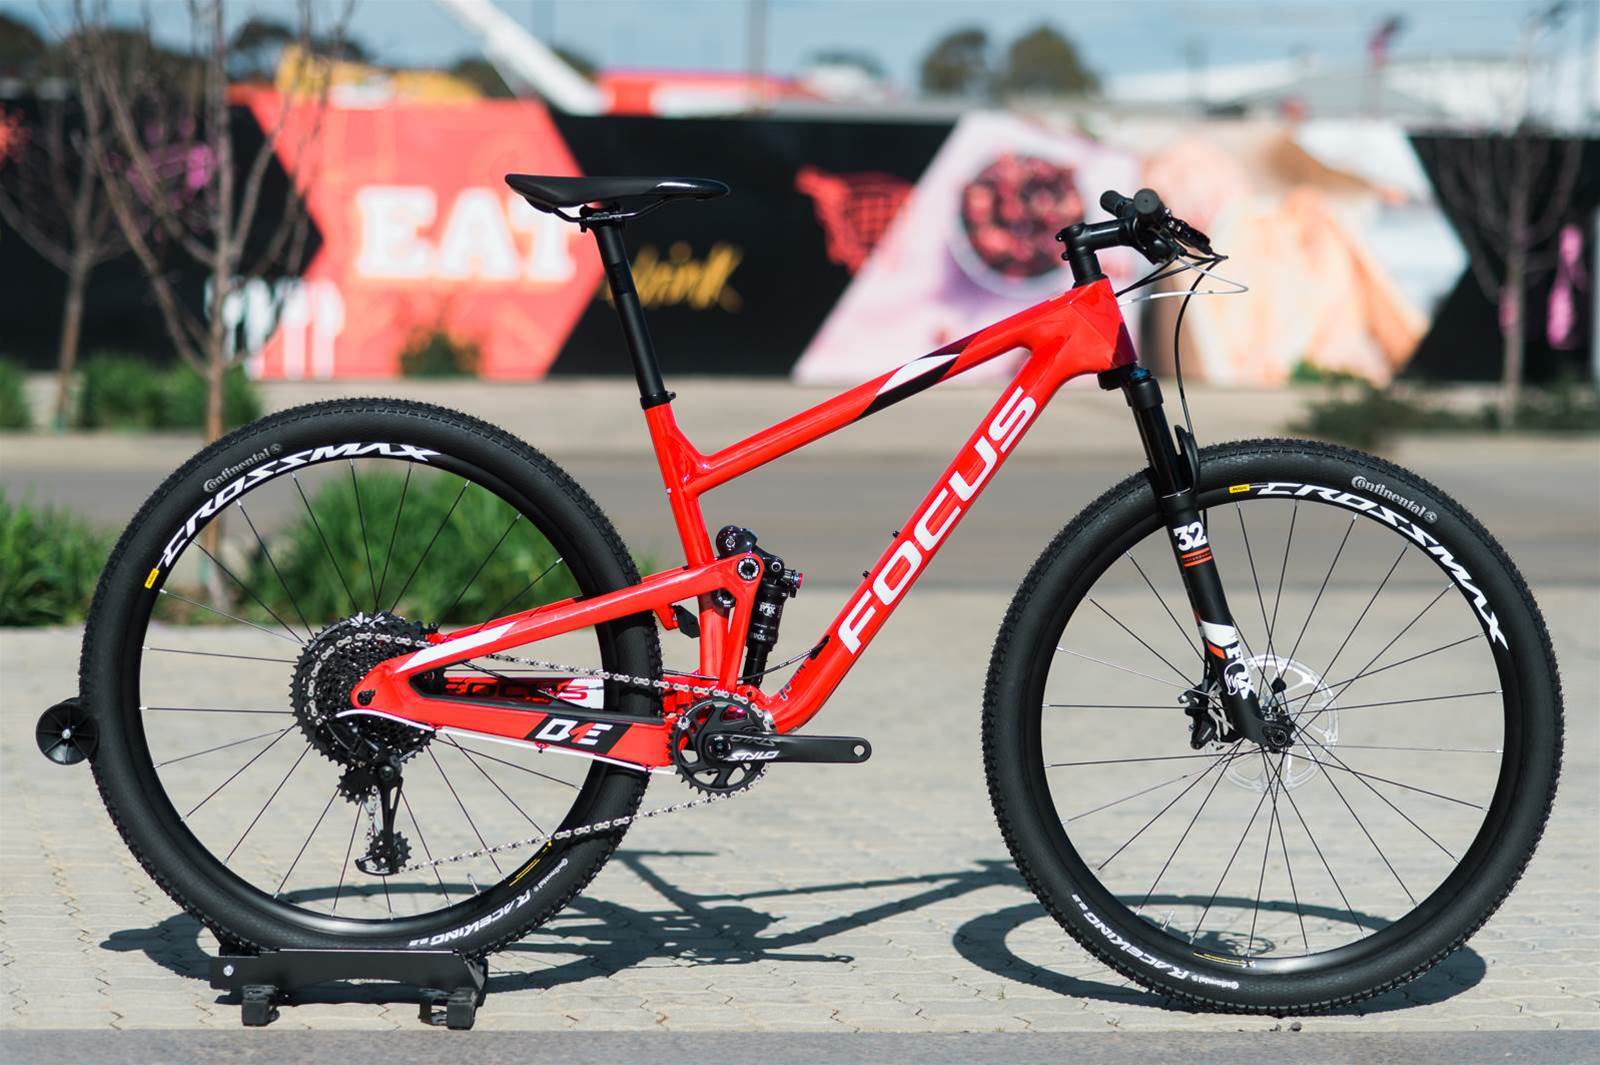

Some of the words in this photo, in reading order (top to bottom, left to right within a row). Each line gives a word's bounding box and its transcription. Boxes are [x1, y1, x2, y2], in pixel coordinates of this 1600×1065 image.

[355, 186, 577, 281] EAT
[162, 442, 442, 567] CROSSMAX
[203, 447, 270, 492] Continental
[1351, 475, 1427, 517] Continental
[838, 386, 1037, 655] FOCUS
[1173, 521, 1208, 552] 32
[1257, 482, 1509, 650] CROSSMAX
